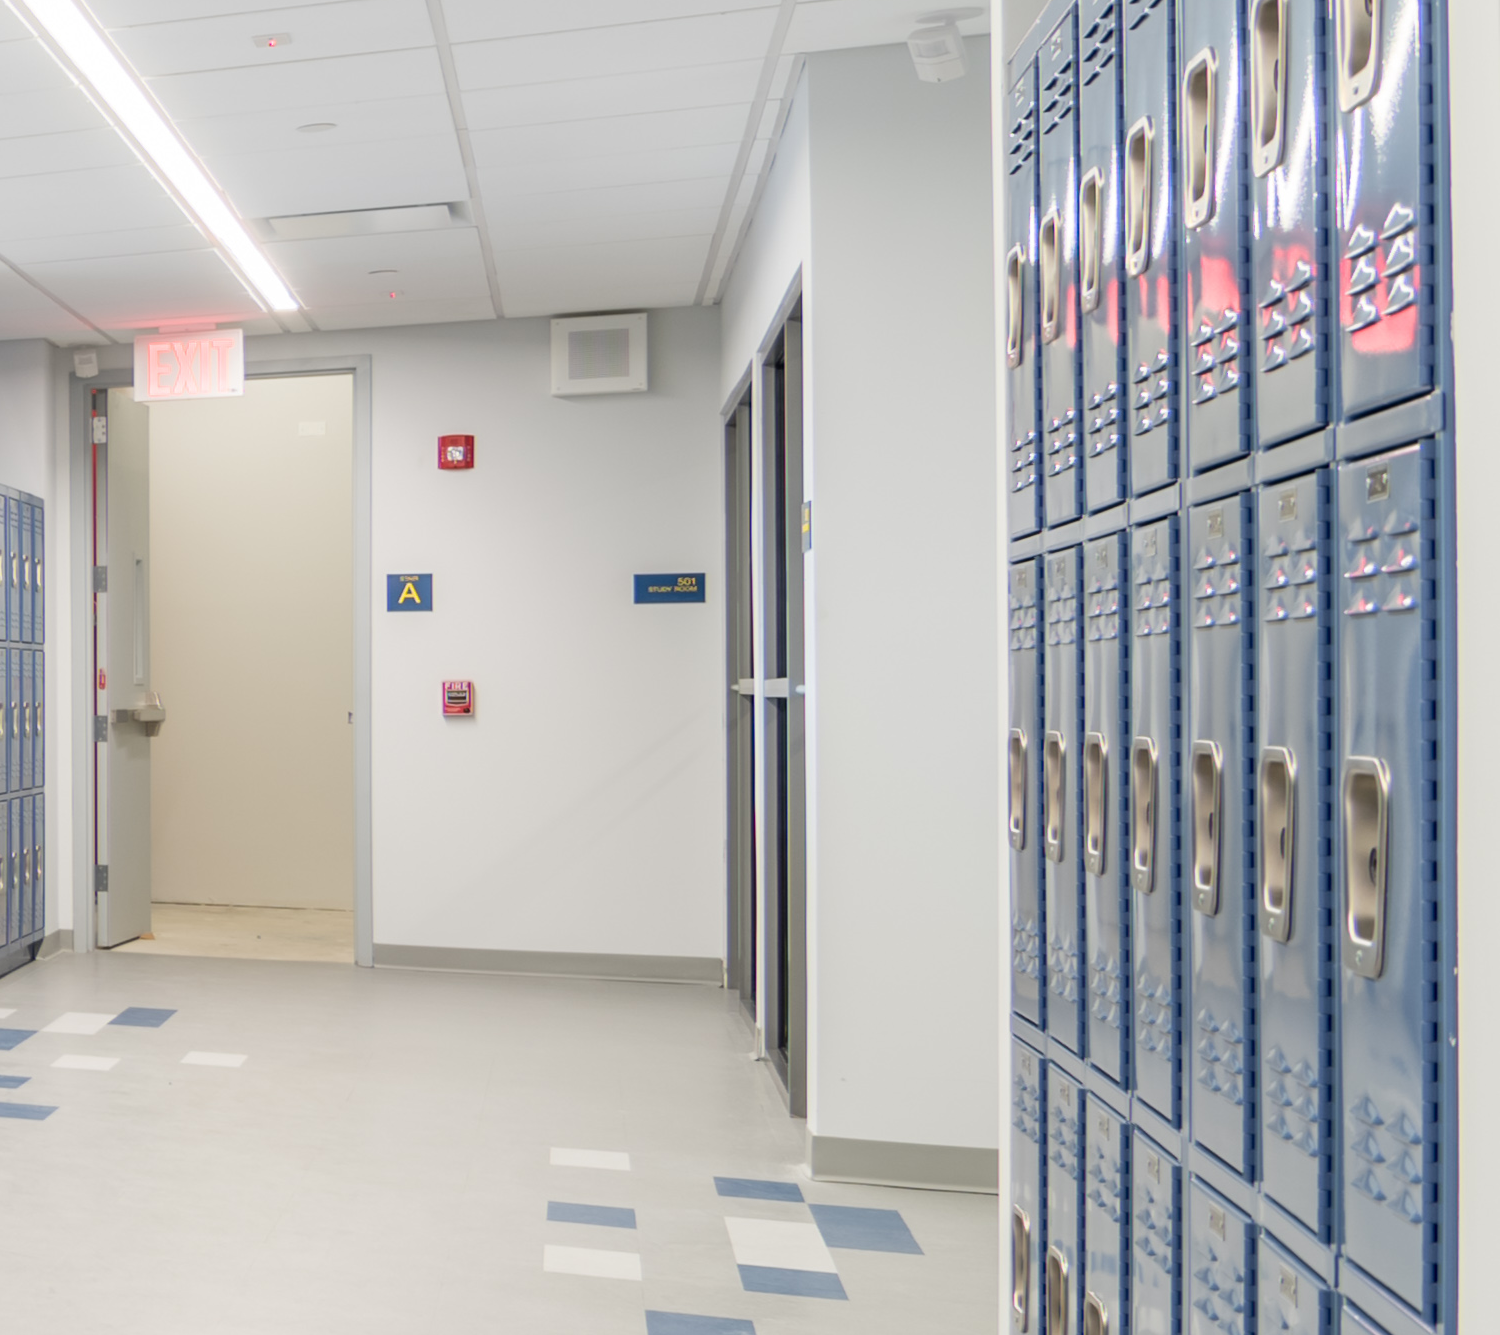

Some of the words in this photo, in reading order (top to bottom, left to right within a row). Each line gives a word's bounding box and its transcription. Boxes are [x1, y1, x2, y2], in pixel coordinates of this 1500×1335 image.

[147, 337, 236, 398] EXIT
[677, 576, 697, 586] 501
[397, 582, 422, 604] A
[647, 585, 673, 593] STUDY
[673, 585, 698, 593] ROOM
[444, 681, 469, 690] FIRE
